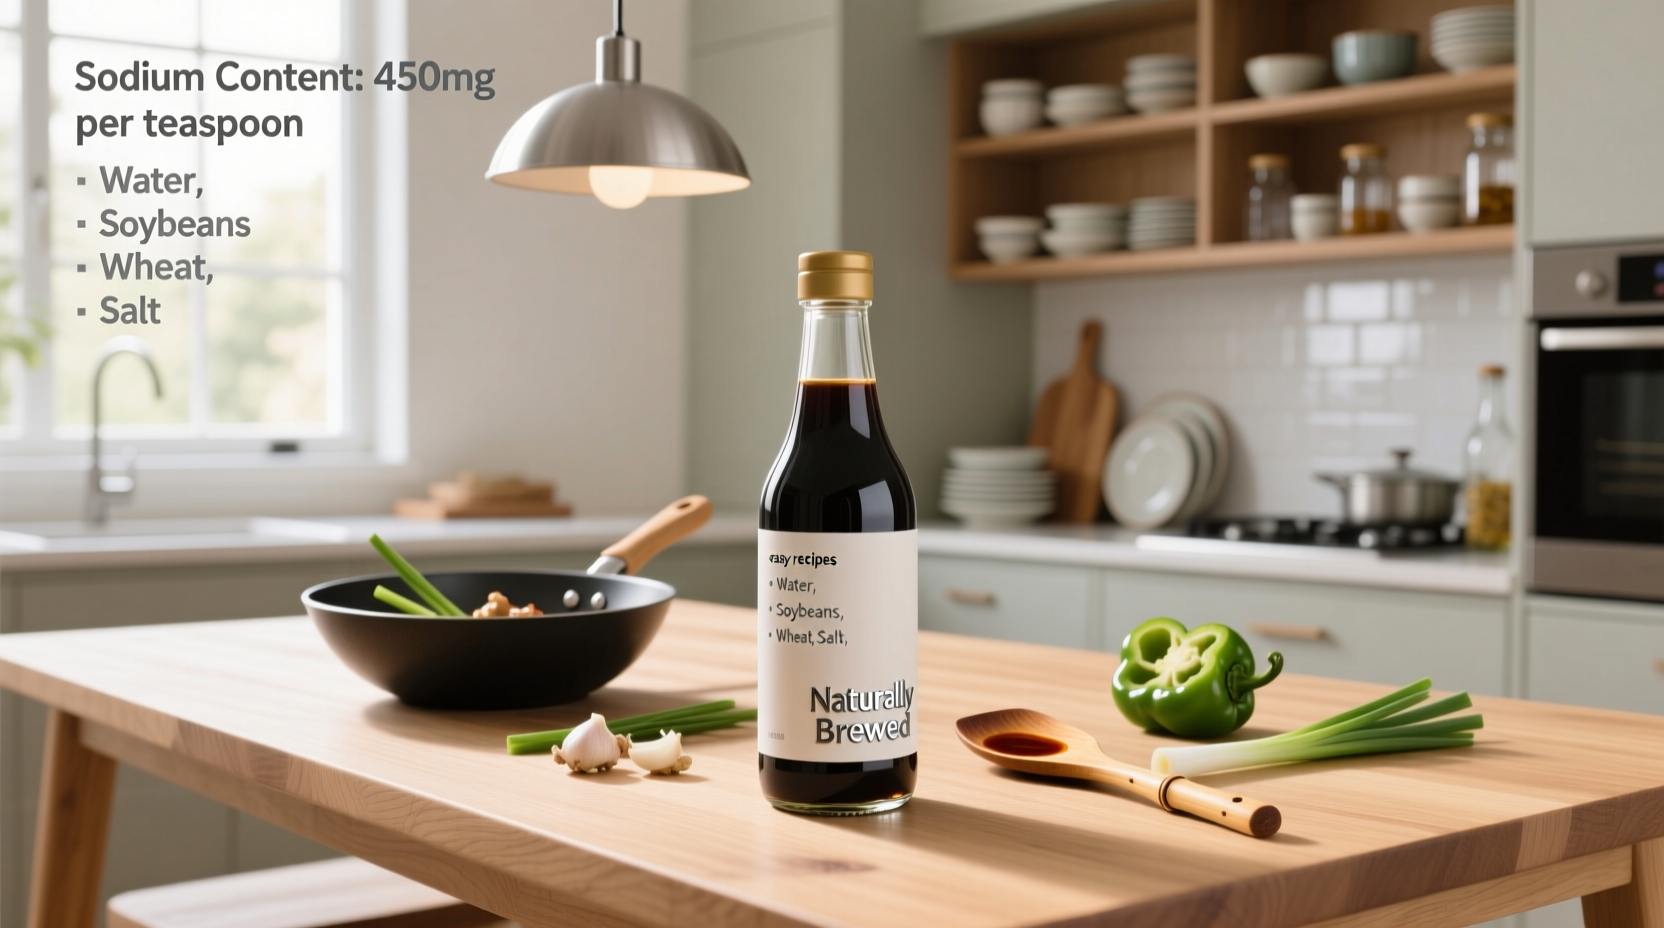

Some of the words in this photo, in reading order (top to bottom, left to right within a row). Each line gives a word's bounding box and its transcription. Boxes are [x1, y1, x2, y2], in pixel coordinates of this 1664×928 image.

[793, 552, 837, 569] recipes
[776, 577, 816, 595] Water,
[776, 603, 844, 621] Soybeans,
[776, 628, 814, 646] Wheat,
[817, 630, 848, 646] Salt,
[810, 679, 914, 712] Naturally
[816, 711, 911, 744] Brewed
